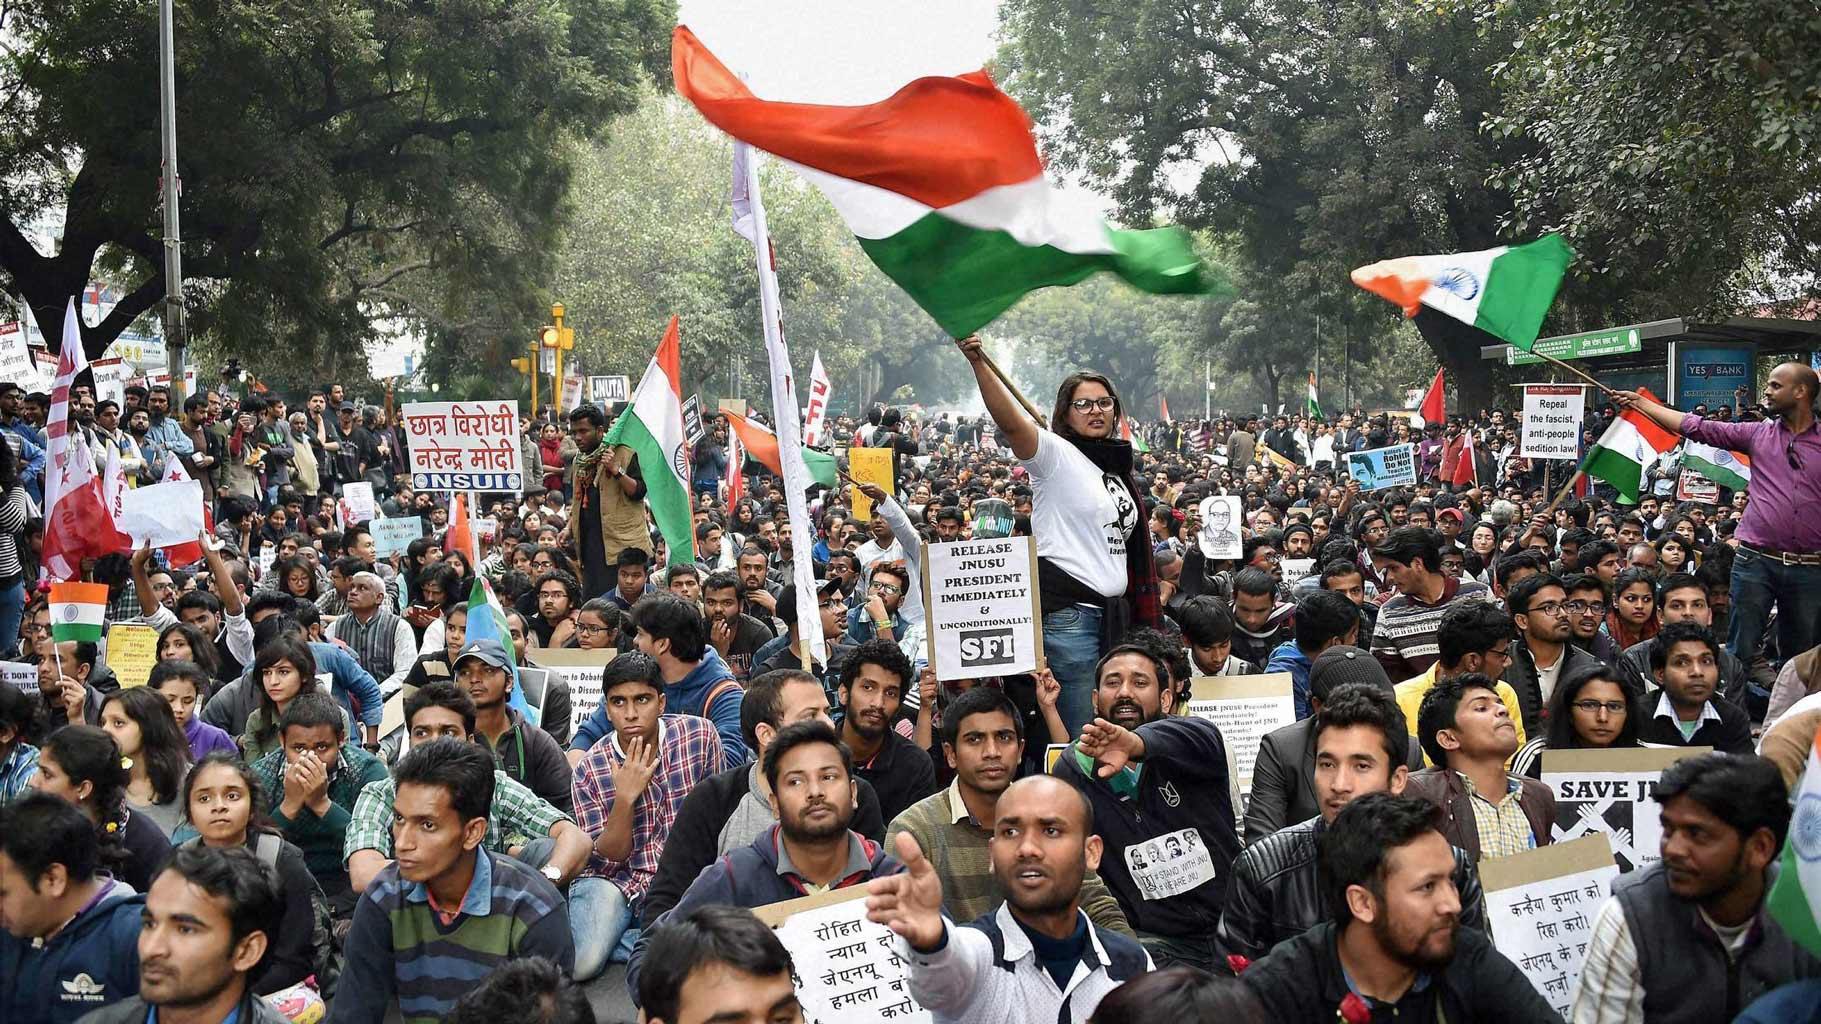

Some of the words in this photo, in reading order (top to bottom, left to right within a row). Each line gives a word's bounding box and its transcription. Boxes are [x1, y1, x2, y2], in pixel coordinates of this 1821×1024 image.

[1689, 366, 1706, 375] YES
[1716, 366, 1742, 375] BANK
[593, 378, 624, 399] JNUTA
[1540, 399, 1567, 410] Repeal
[407, 415, 446, 436] छात्र
[452, 404, 514, 436] विरोधी
[1530, 414, 1543, 423] the
[1545, 414, 1575, 424] fascist,
[1529, 429, 1575, 440] anti-people
[414, 438, 462, 471] नरेन्द्र
[468, 438, 514, 471] मोदी
[1525, 443, 1558, 453] sedition
[1560, 443, 1577, 453] law!
[1383, 451, 1410, 463] Rohith
[1385, 462, 1396, 470] Do
[1397, 458, 1411, 467] Not
[431, 474, 504, 489] NSUI
[951, 543, 1012, 557] RELEASE
[959, 558, 1005, 571] JNUSU
[944, 573, 1022, 588] PRESIDENT
[941, 588, 1027, 603] IMMEDIATELY
[980, 606, 990, 615] &
[940, 617, 1032, 630] UNCONDITIONALLY!
[960, 635, 1014, 661] SFI
[11, 672, 37, 680] DON'T
[571, 673, 578, 681] to
[580, 672, 603, 681] Debate
[578, 686, 603, 694] Dissent
[579, 699, 600, 709] Argue
[1220, 704, 1242, 713] JNUSU
[575, 712, 590, 725] JN
[1263, 718, 1279, 726] JNU
[1561, 780, 1629, 799] SAVE
[1180, 859, 1197, 872] WITH
[1197, 853, 1208, 867] JNU
[1174, 876, 1187, 888] ARE
[1187, 871, 1199, 884] JNU
[1509, 894, 1545, 918] कन्हैया
[1549, 889, 1582, 913] कुमार
[1584, 880, 1601, 899] को
[814, 919, 863, 941] रोहित
[1536, 922, 1559, 941] रिहा
[826, 941, 867, 960] न्याय
[876, 929, 895, 948] दो
[1520, 952, 1557, 973] जेएनयू
[1557, 943, 1572, 961] के
[821, 963, 884, 987] जेएनयू
[829, 985, 879, 1010] हमला
